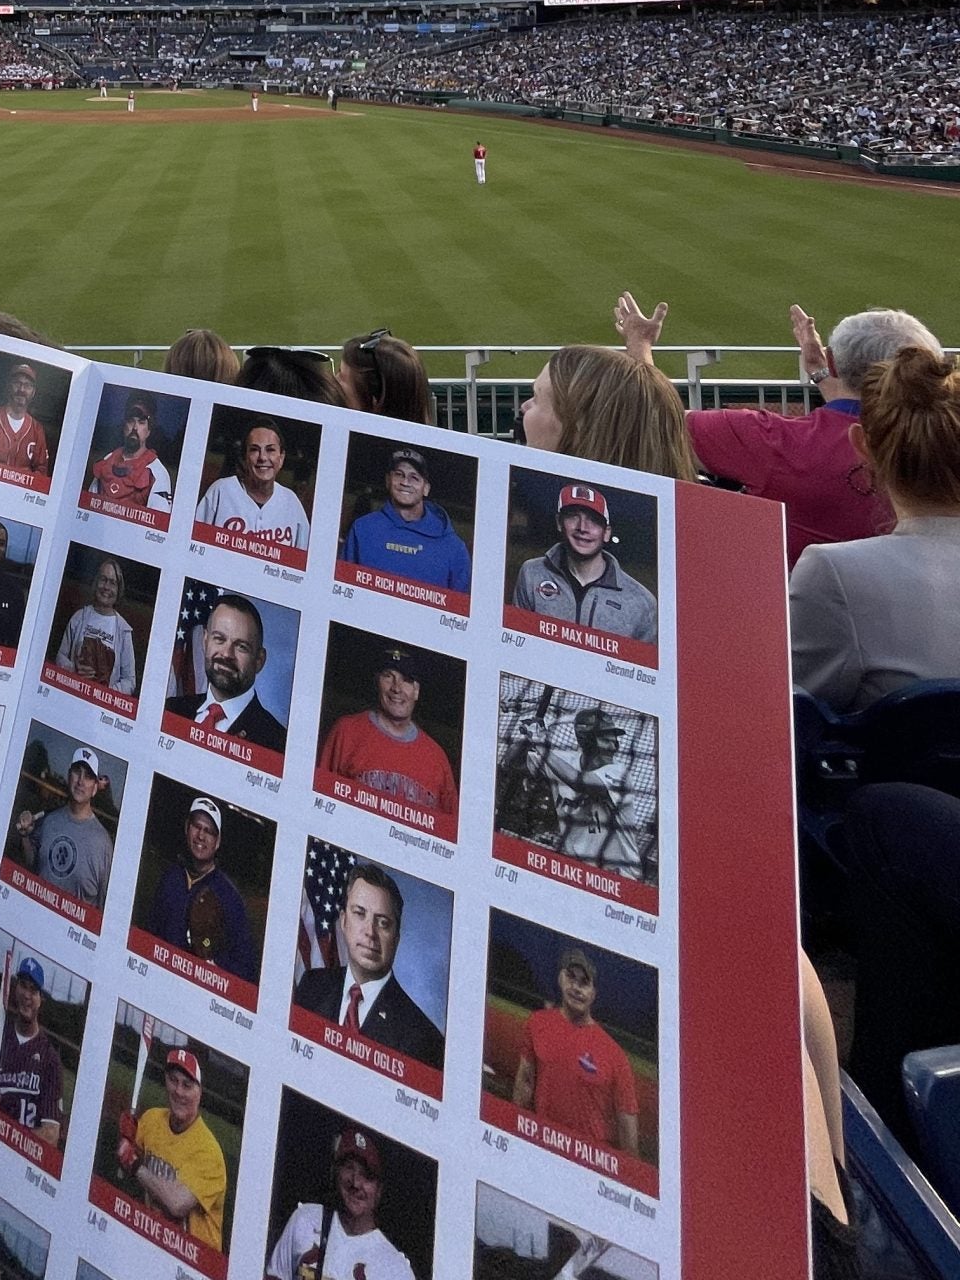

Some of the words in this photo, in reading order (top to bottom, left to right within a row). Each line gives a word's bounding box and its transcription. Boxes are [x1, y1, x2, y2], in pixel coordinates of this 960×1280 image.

[1, 468, 34, 486] BURCHETT
[90, 497, 102, 510] REP.
[103, 500, 127, 517] MORGAN
[127, 507, 155, 525] LUTTRELL
[215, 532, 230, 546] REP.
[231, 536, 248, 550] LISA
[248, 540, 281, 559] MCCLAIN
[356, 570, 373, 586] REP.
[375, 575, 395, 593] RICH
[396, 581, 447, 607] MCCORMICK
[440, 614, 468, 631] Outfield
[539, 620, 559, 640] REP.
[561, 626, 582, 645] MAX
[583, 633, 619, 654] MILLER
[605, 661, 634, 681] Second
[636, 668, 656, 685] Base
[45, 668, 56, 682] REP.
[92, 687, 134, 713] MILLER-MEEKS
[189, 727, 206, 744] REP.
[206, 732, 228, 751] CORY
[228, 741, 252, 762] MILLS
[245, 771, 264, 788] Right
[334, 781, 352, 801] REP.
[354, 788, 379, 812] JOHN
[380, 796, 435, 831] MOOLENAAR
[389, 825, 431, 853] Designated
[431, 839, 455, 860] Hitter
[527, 852, 548, 871] REP.
[551, 859, 583, 884] BLAKE
[585, 871, 622, 898] MOORE
[12, 871, 25, 885] REP.
[25, 876, 61, 910] NATHANIEL
[62, 896, 86, 923] MORAN
[604, 904, 634, 926] Center
[635, 914, 658, 934] Field
[153, 944, 171, 965] REP.
[171, 953, 193, 975] GREG
[194, 962, 229, 993] MURPHY
[177, 1049, 186, 1061] R
[324, 1027, 344, 1048] REP.
[345, 1038, 372, 1062] ANDY
[374, 1051, 405, 1077] OGLES
[17, 1098, 38, 1129] 12
[395, 1088, 419, 1111] Short
[420, 1098, 439, 1122] Stop
[11, 1130, 44, 1163] PFLUGER
[482, 1131, 510, 1153] AL-06
[517, 1115, 540, 1138] REP.
[542, 1126, 572, 1153] GARY
[574, 1139, 618, 1176] PALMER
[114, 1197, 133, 1221] REP.
[134, 1210, 162, 1241] STEVE
[162, 1226, 200, 1265] SCALISE
